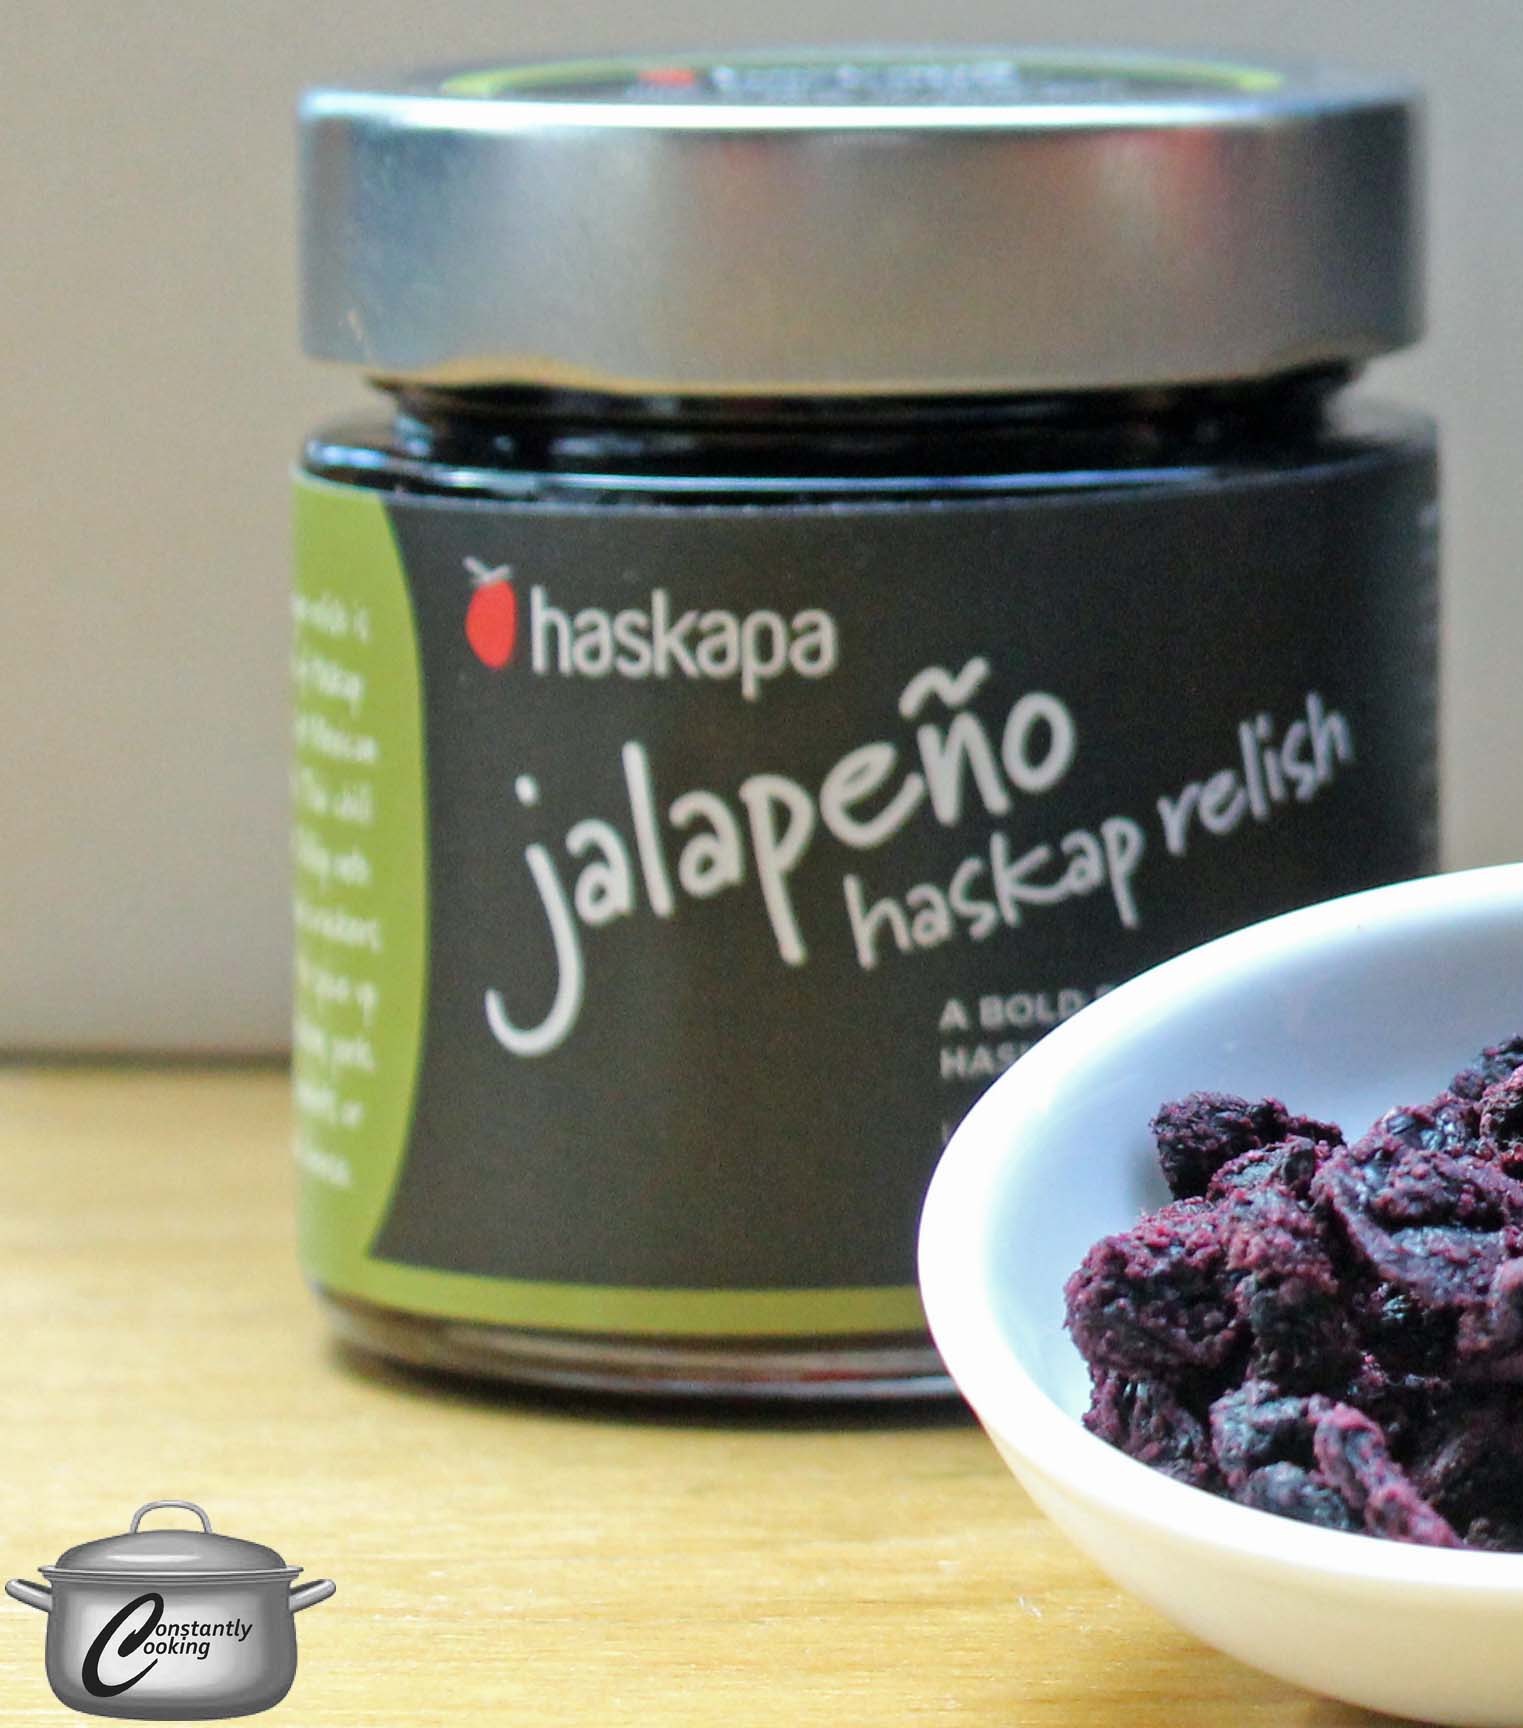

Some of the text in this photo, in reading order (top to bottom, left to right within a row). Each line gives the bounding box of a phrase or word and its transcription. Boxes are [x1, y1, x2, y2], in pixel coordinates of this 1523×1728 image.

[530, 584, 840, 700] haskapa
[484, 654, 1076, 1058] jalapeño
[842, 690, 1354, 970] haskap relish
[939, 996, 969, 1032] A
